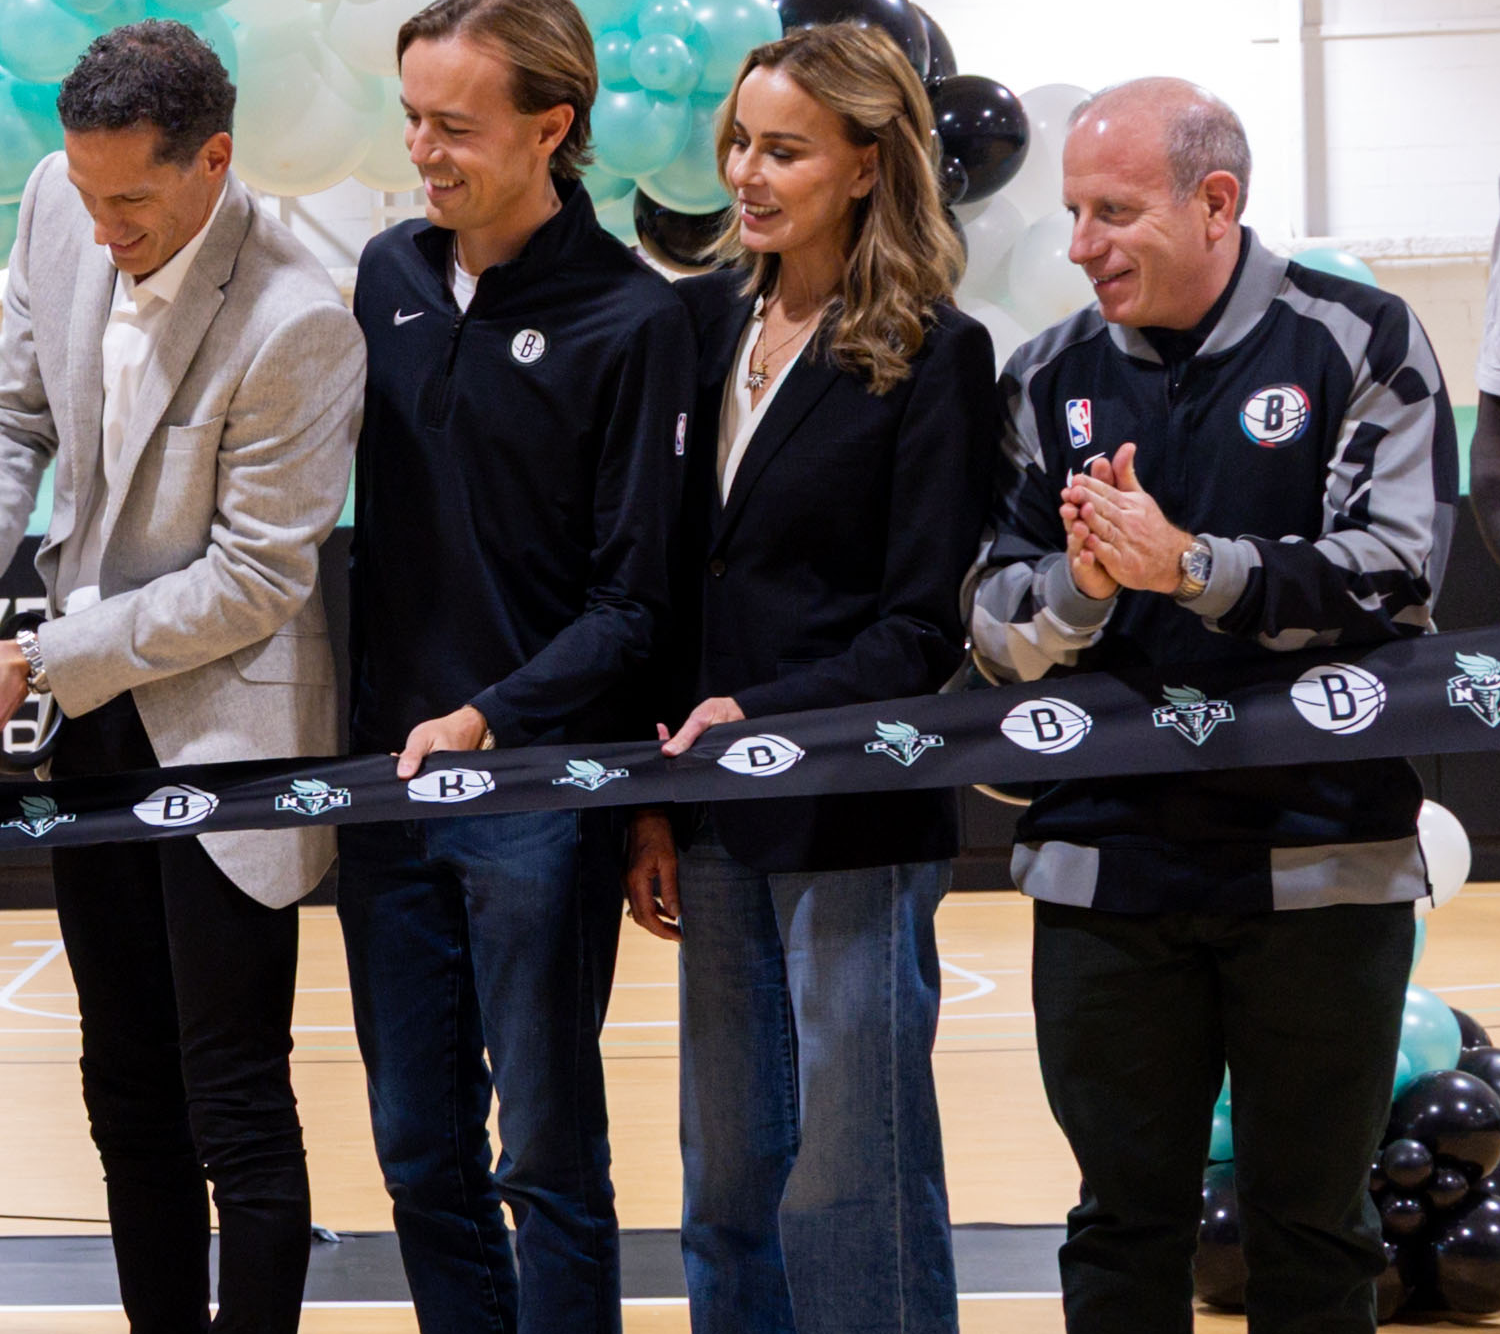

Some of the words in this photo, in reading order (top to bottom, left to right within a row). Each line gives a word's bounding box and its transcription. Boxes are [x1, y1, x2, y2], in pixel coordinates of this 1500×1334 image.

[1263, 394, 1285, 432] B
[1317, 673, 1357, 722] B
[1029, 708, 1064, 743] B
[746, 744, 777, 768] B
